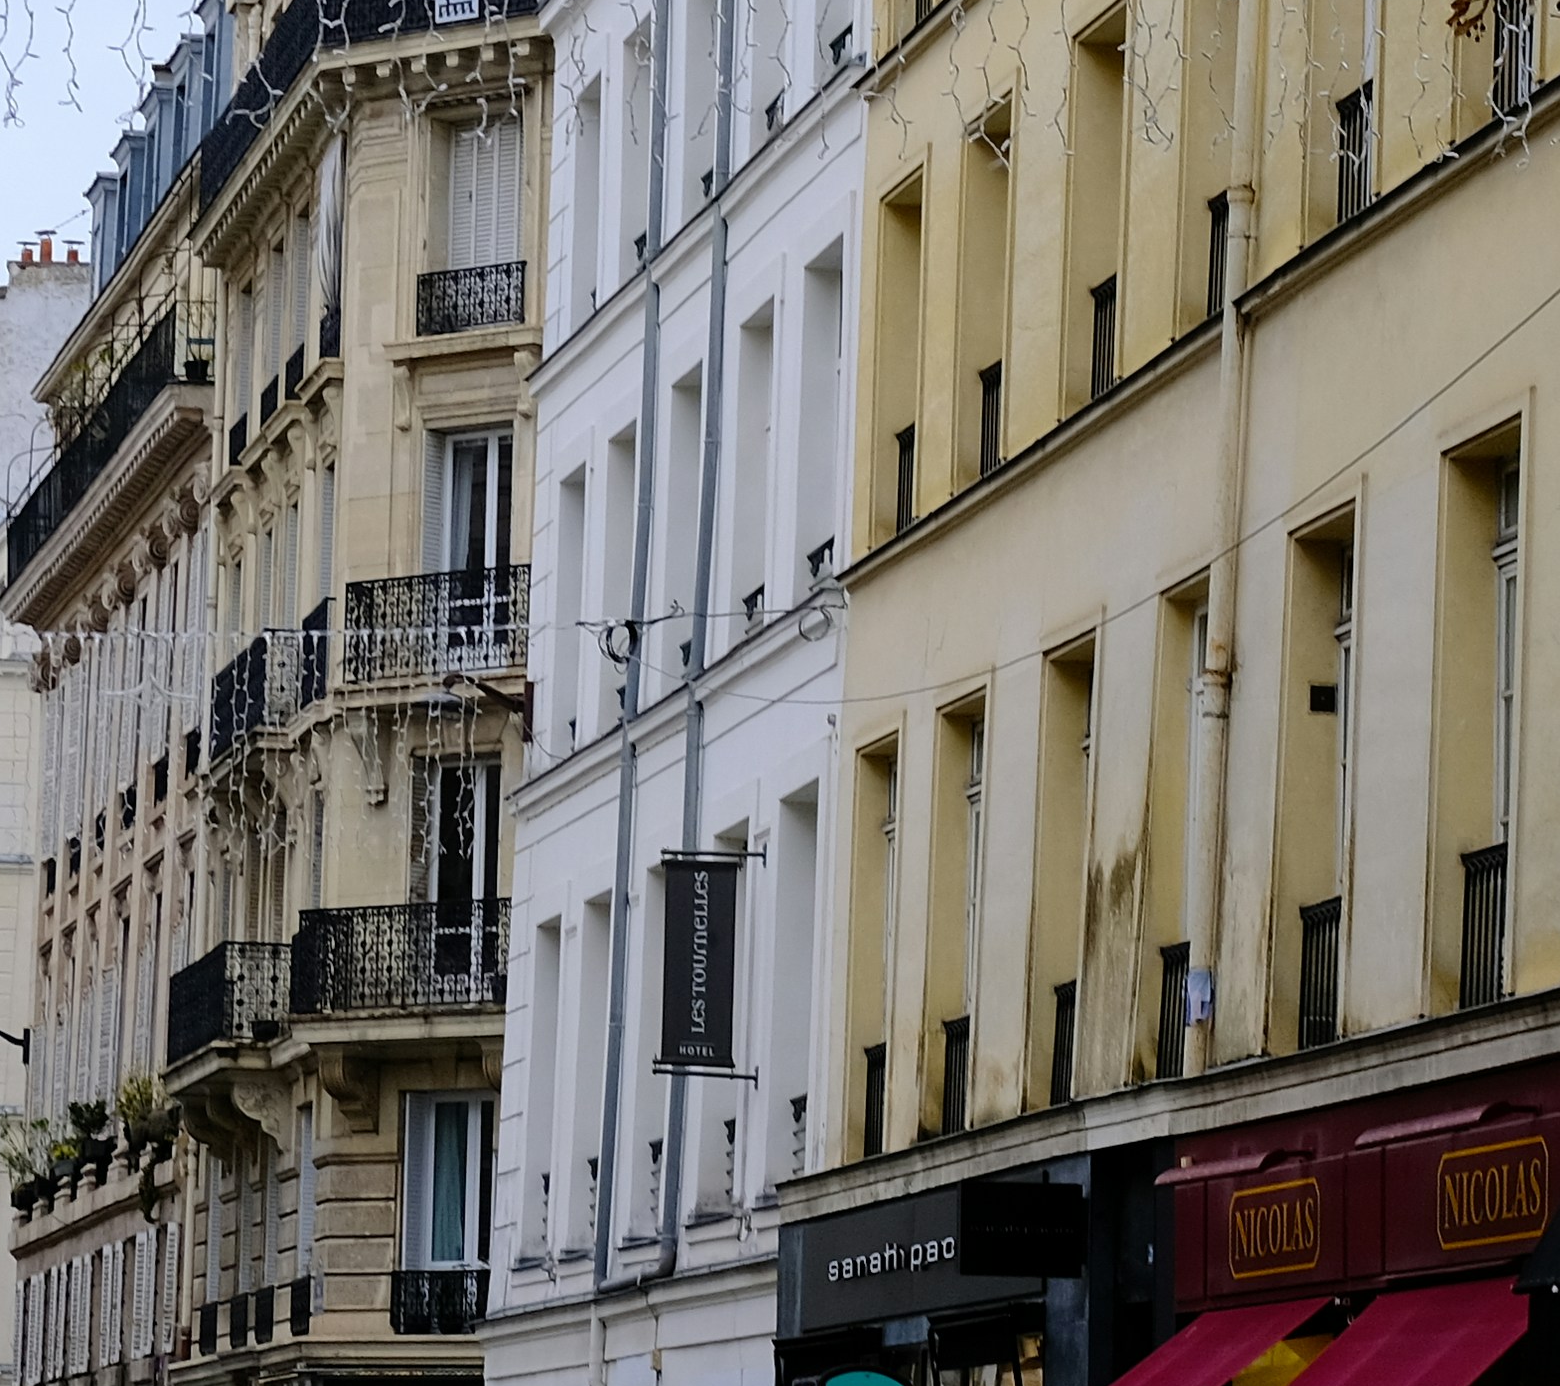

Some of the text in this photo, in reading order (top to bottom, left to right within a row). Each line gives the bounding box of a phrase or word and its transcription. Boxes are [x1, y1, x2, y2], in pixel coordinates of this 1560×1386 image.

[678, 1045, 715, 1057] HOTEL
[1443, 1157, 1541, 1230] NICOLAS
[1235, 1196, 1314, 1261] NICOLAS
